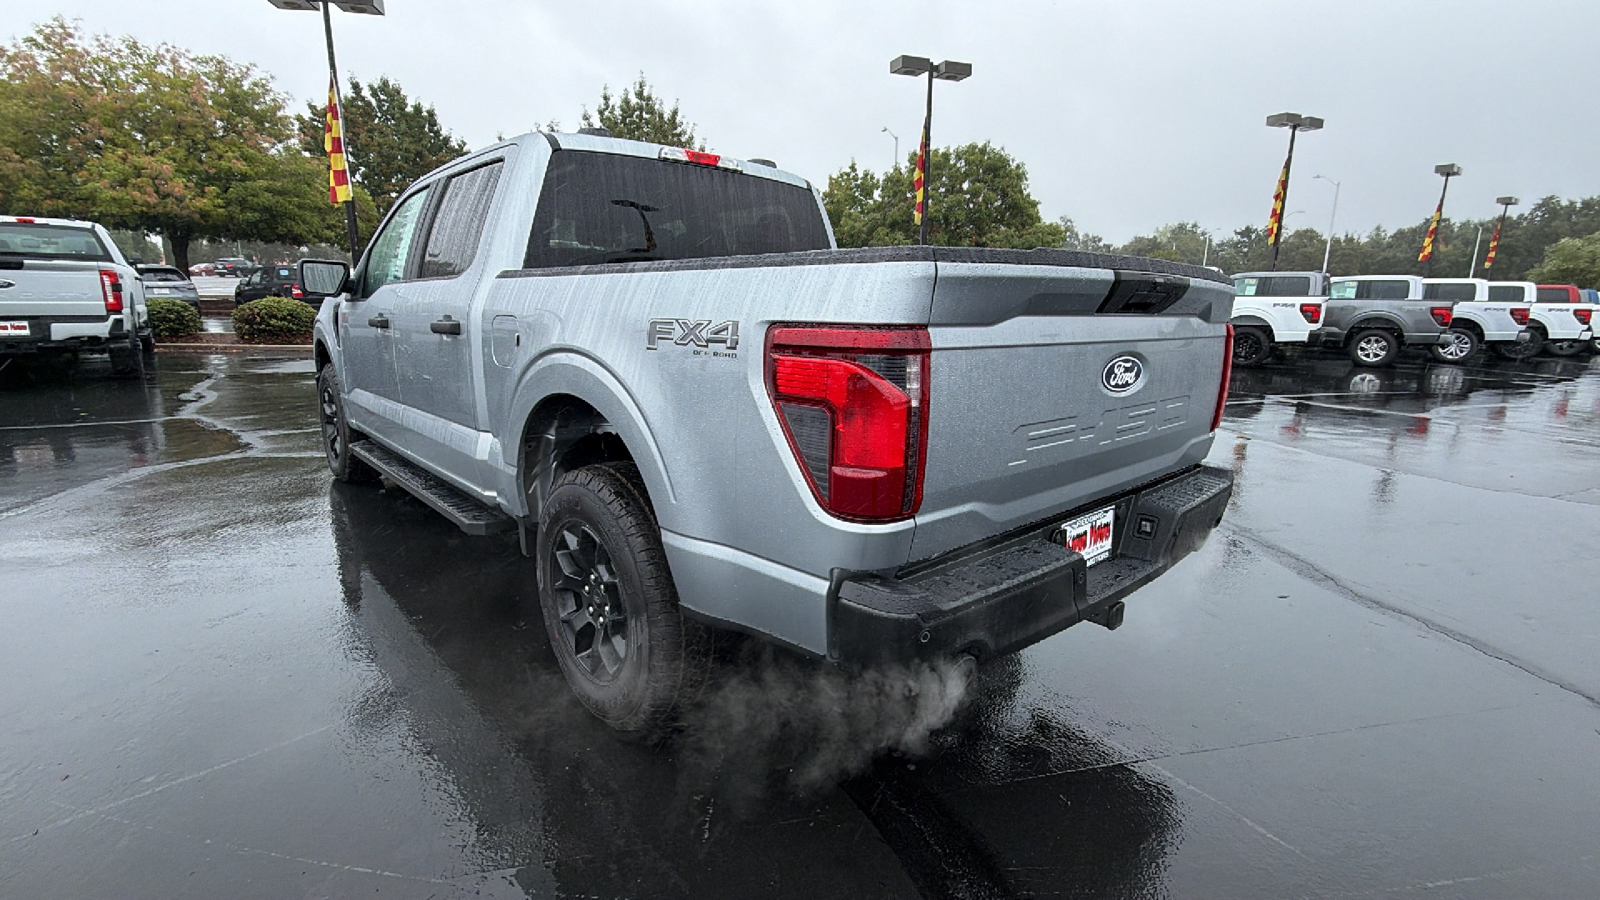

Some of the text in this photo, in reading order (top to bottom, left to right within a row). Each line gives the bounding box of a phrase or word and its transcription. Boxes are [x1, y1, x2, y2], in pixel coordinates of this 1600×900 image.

[646, 317, 740, 351] FX4
[712, 350, 738, 359] ROAD
[1109, 361, 1139, 387] Ford
